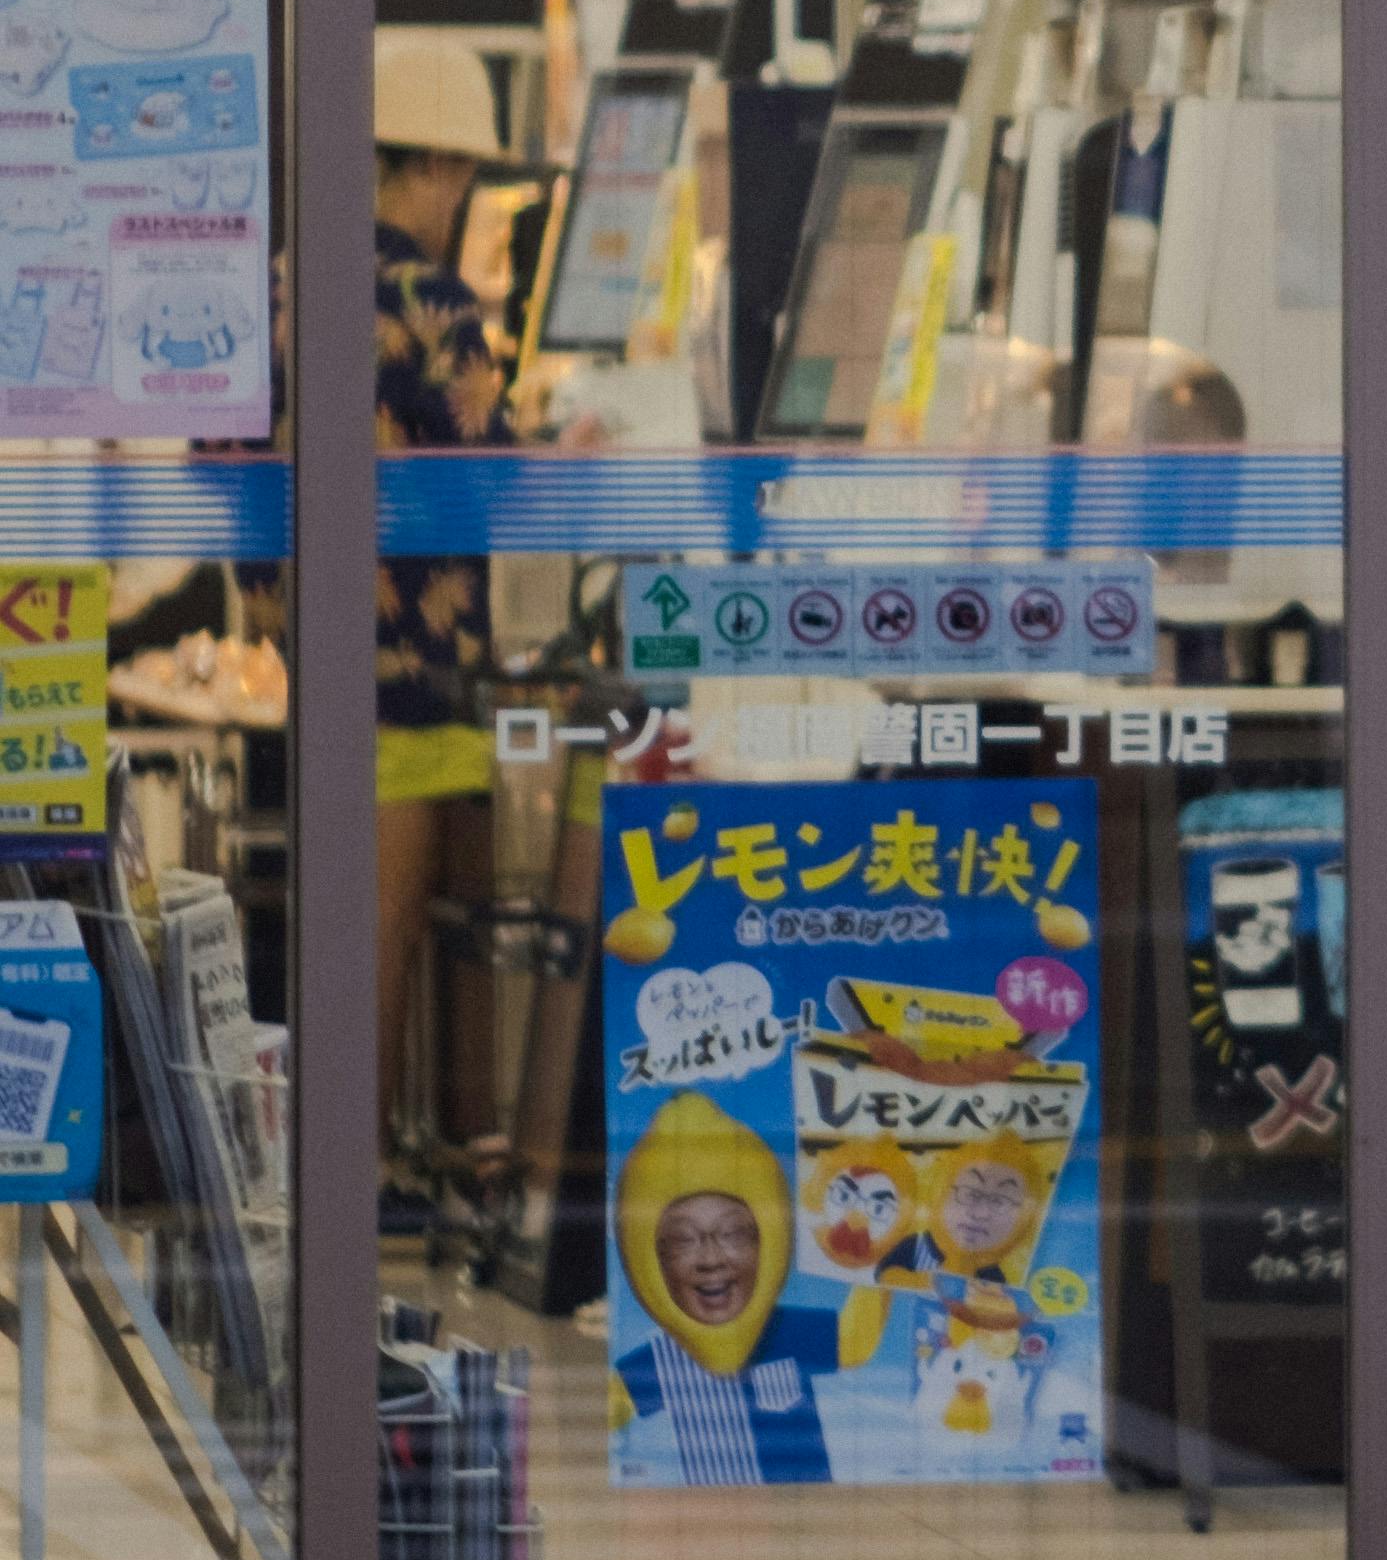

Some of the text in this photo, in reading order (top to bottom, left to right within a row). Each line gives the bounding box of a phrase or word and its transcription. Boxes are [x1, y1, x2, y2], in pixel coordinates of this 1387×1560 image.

[620, 809, 1080, 912] レモン爽快!
[1007, 968, 1080, 1018] 新作
